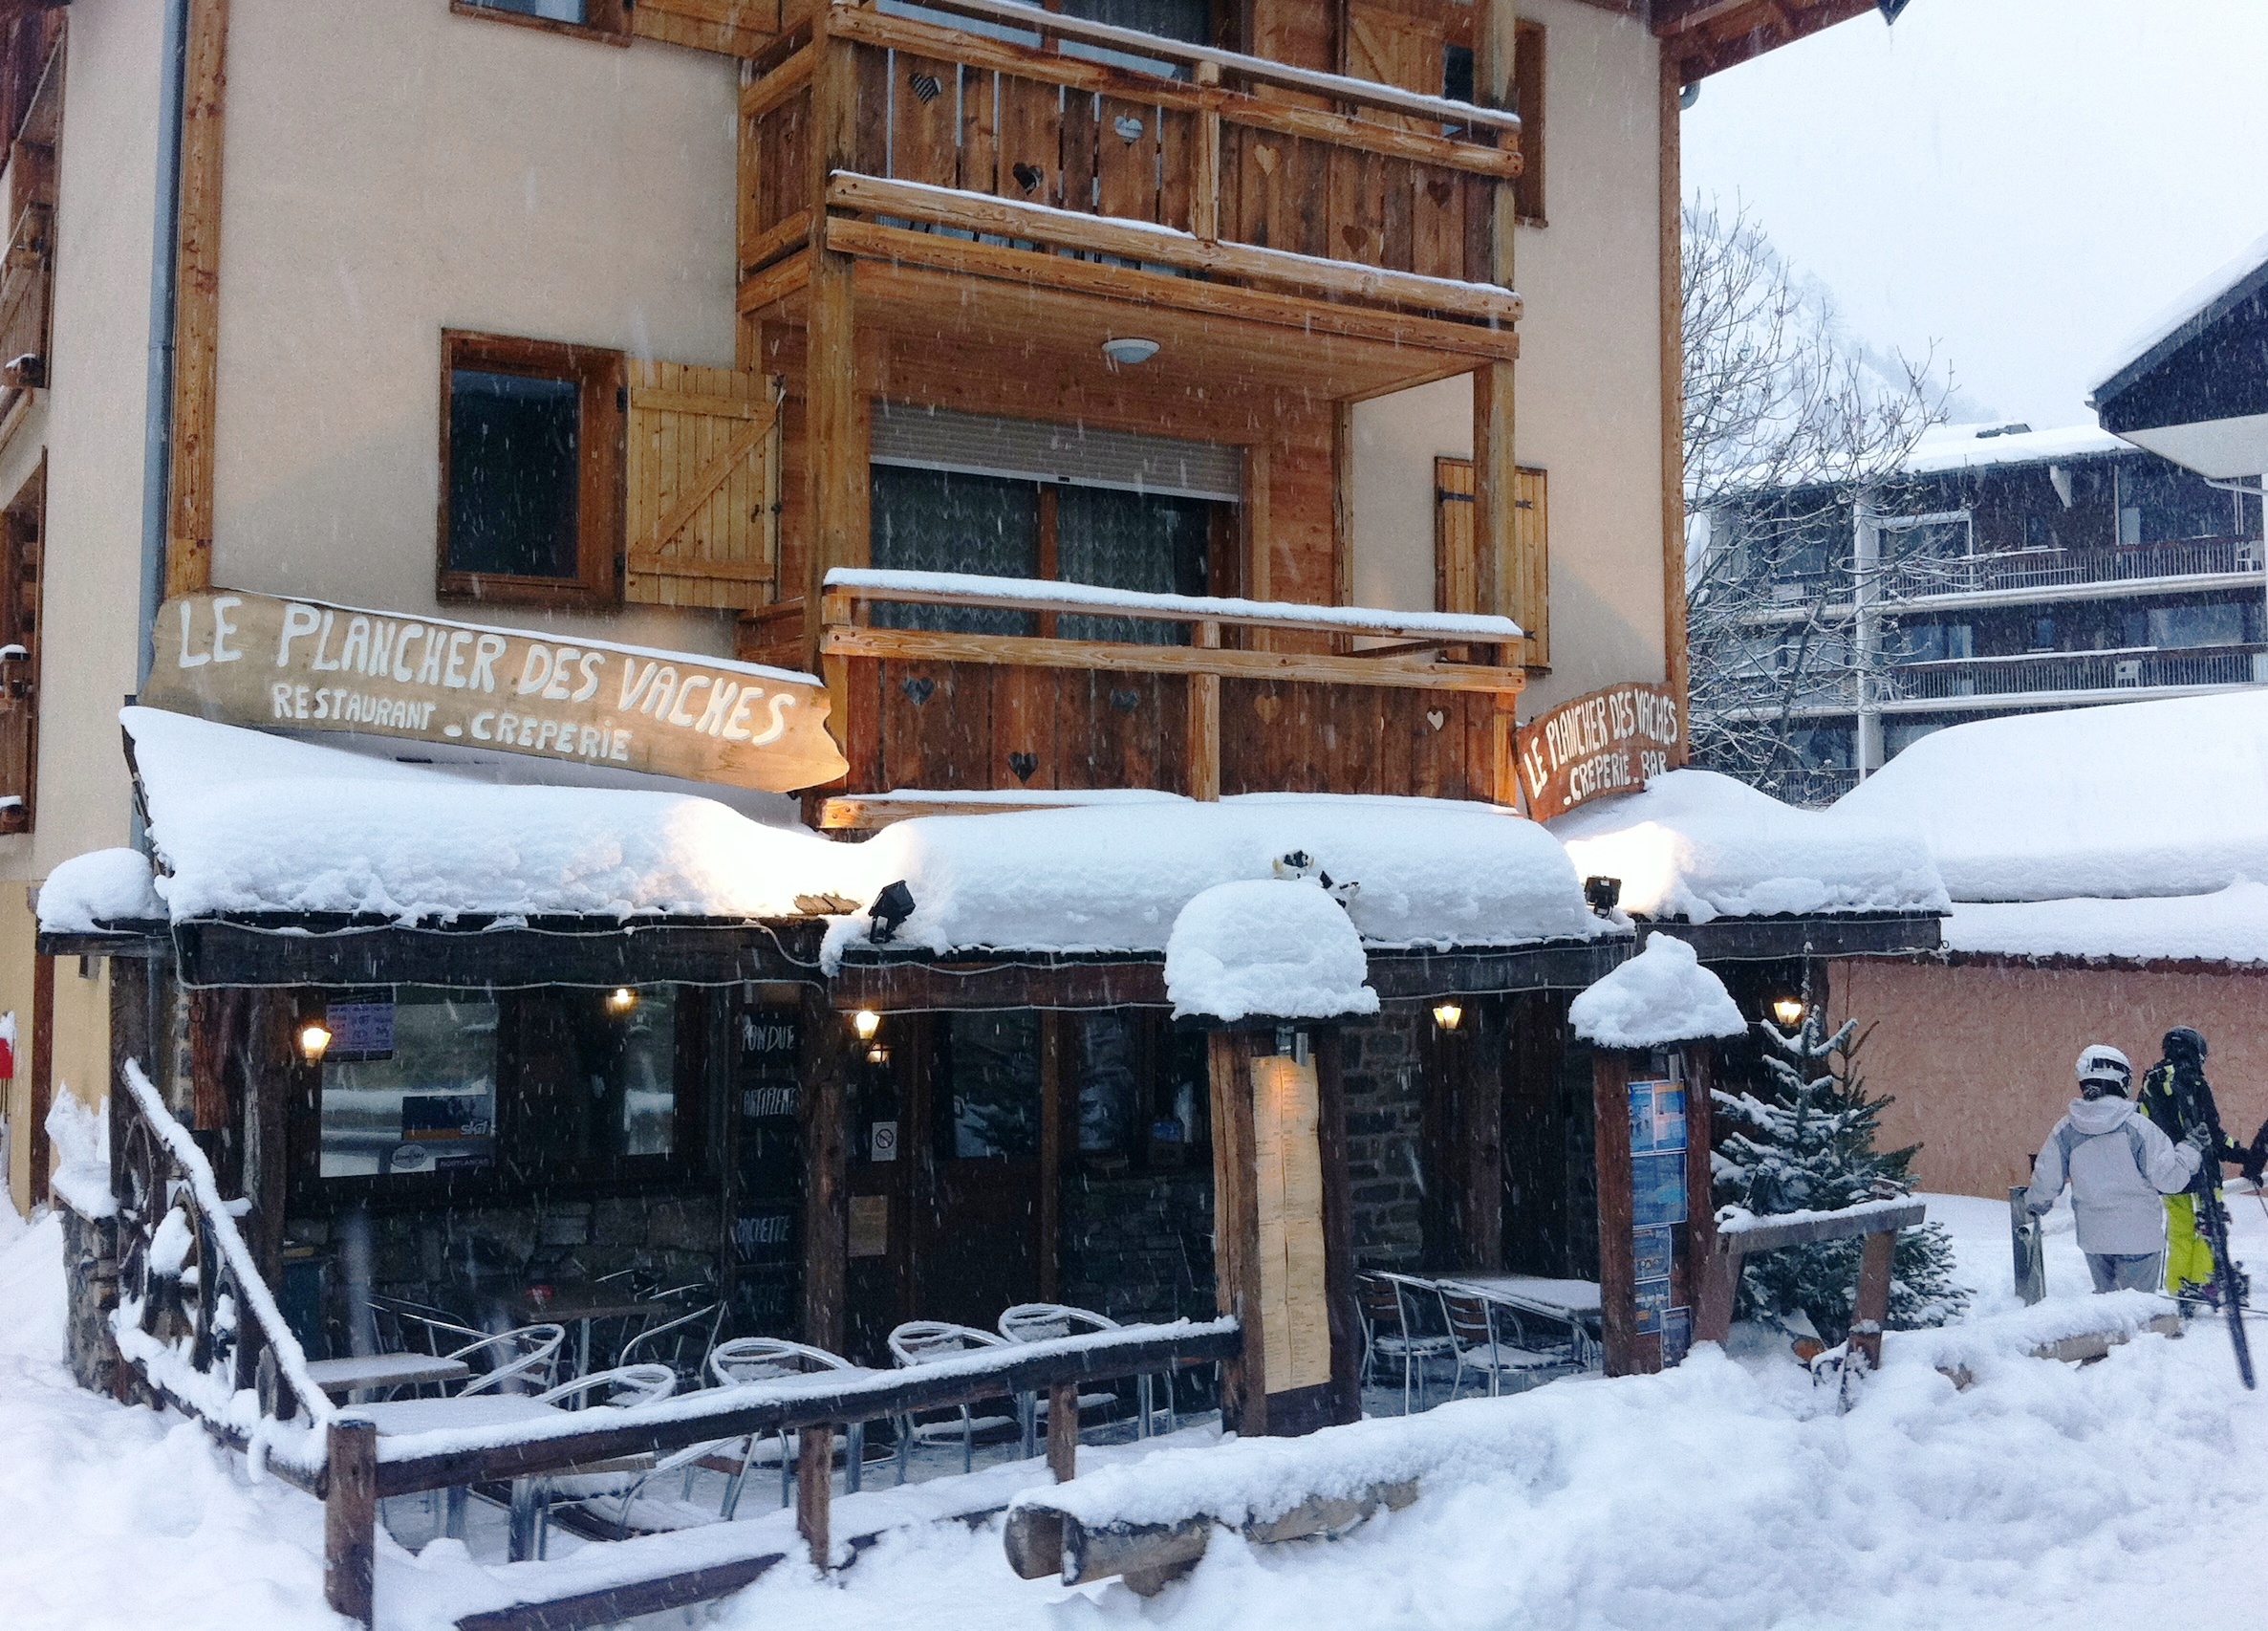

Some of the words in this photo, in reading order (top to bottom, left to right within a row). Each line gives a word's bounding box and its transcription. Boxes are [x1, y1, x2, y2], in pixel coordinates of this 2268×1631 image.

[180, 597, 243, 668] LE
[276, 603, 507, 693] PLANCHER
[517, 643, 606, 703] DES
[617, 658, 797, 746] VACHES
[271, 683, 436, 729] RESTAURANT
[1523, 736, 1548, 799] LE
[1545, 696, 1609, 772] PLANCHER
[1609, 691, 1635, 740] DES
[1633, 688, 1678, 745] VACHES
[1640, 750, 1667, 780] BAR
[742, 1024, 794, 1053] FONDUE
